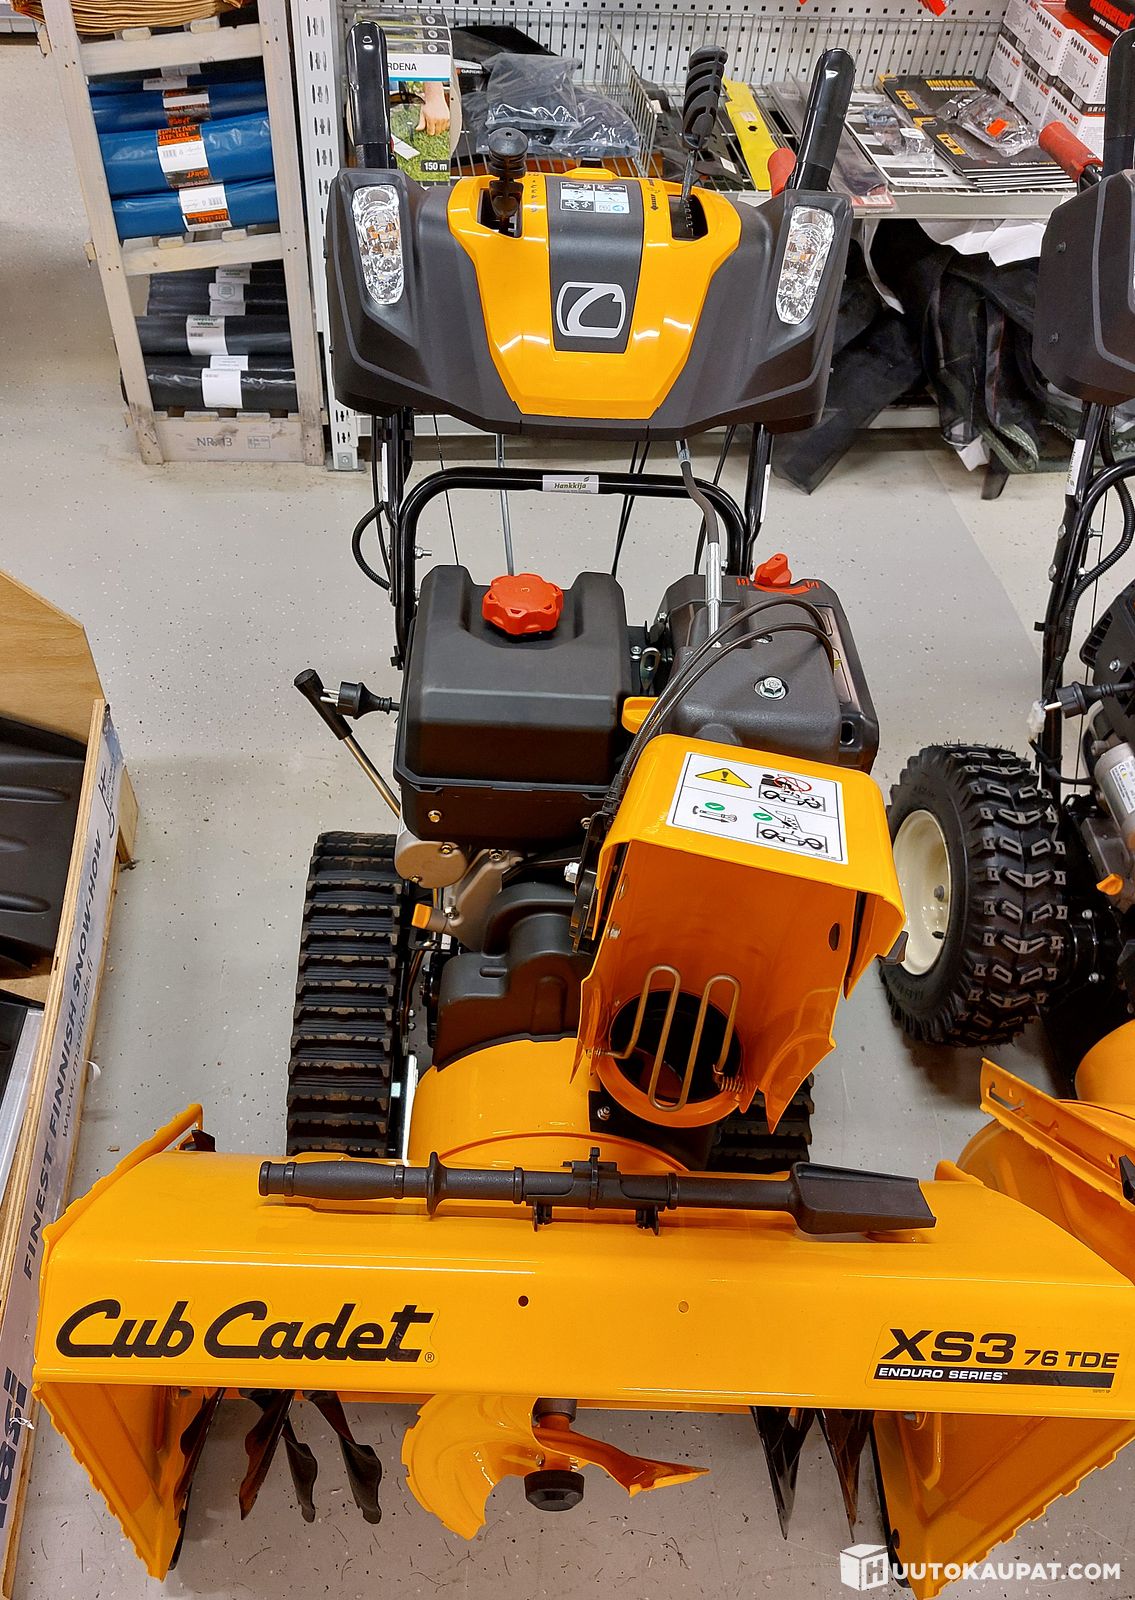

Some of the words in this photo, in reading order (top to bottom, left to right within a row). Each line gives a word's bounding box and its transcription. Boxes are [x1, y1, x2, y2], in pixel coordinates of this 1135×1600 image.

[387, 62, 417, 71] RDENA
[424, 161, 439, 171] 150
[554, 482, 587, 490] Hankkija
[23, 1141, 51, 1280] FINEST
[49, 999, 77, 1138] FINNISH
[72, 829, 101, 997] SNOW-HOW
[56, 1298, 195, 1358] Cub
[880, 1328, 1017, 1365] XS3
[1024, 1349, 1059, 1367] 76
[1065, 1351, 1120, 1369] TDE
[879, 1367, 944, 1379] ENDURO
